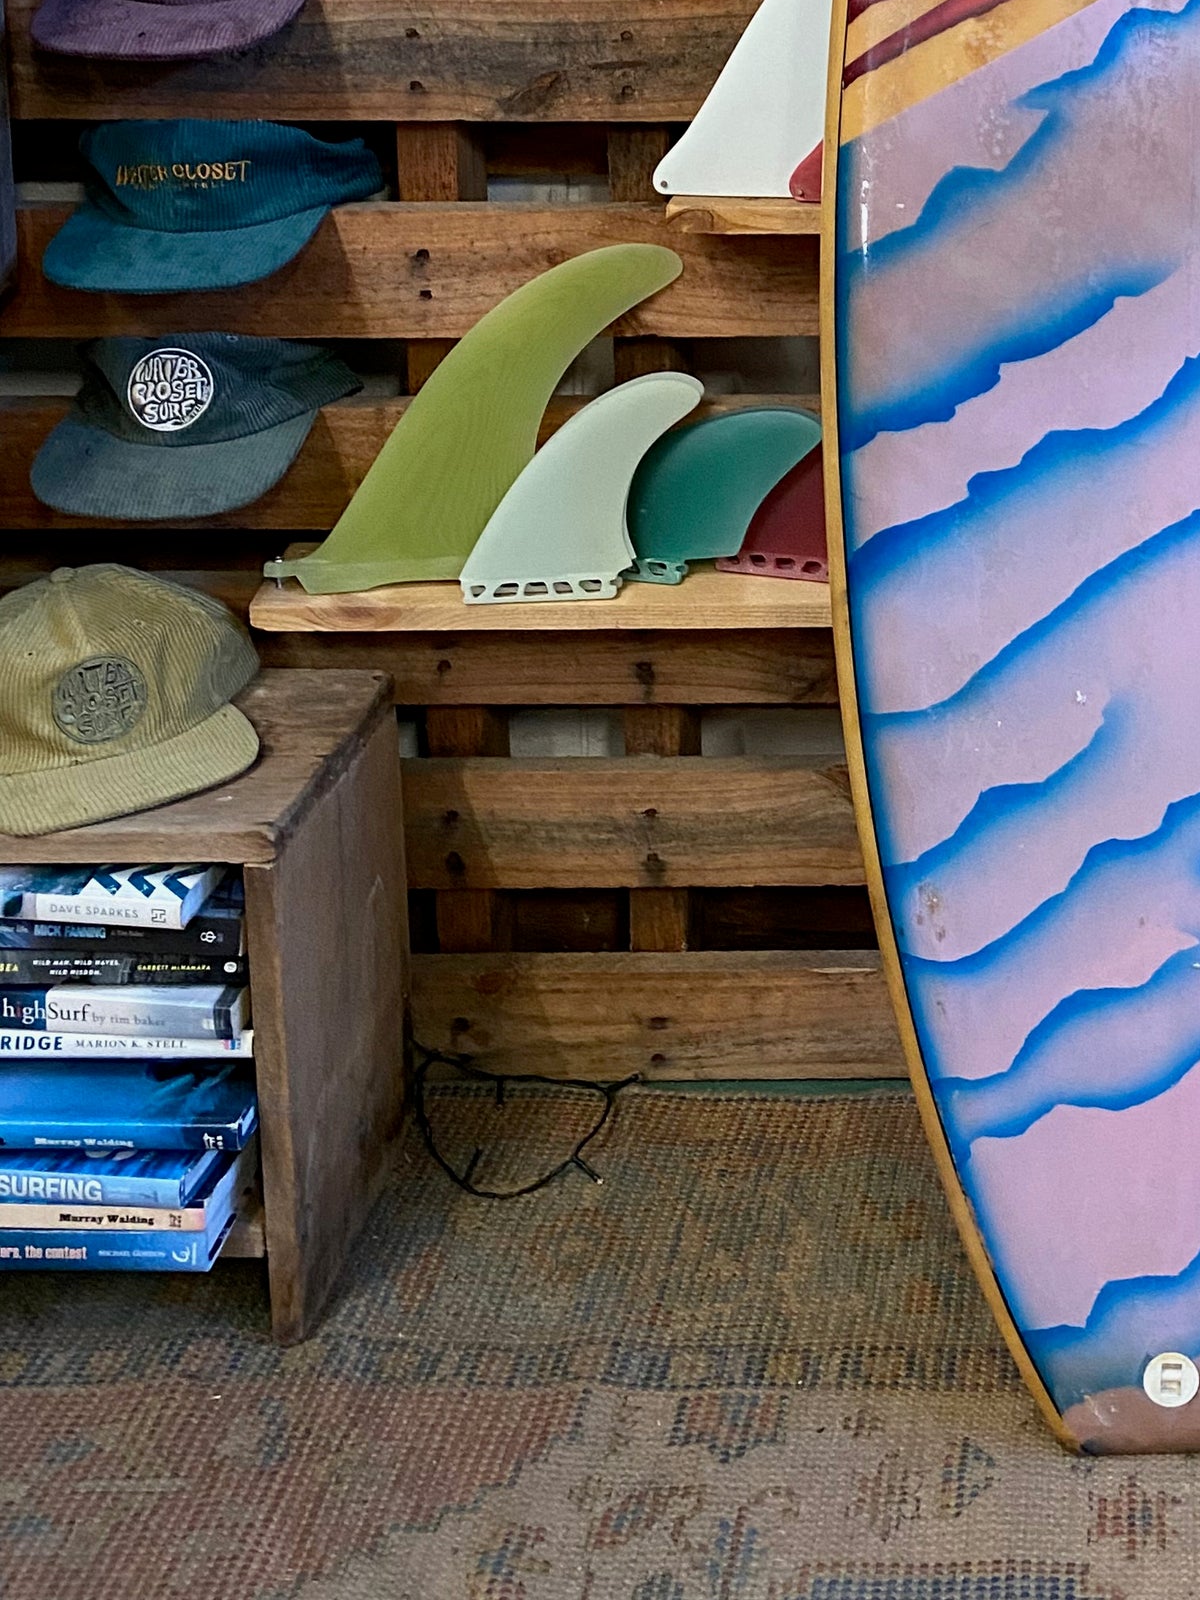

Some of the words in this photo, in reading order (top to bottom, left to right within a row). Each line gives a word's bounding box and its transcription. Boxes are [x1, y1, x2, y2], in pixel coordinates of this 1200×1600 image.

[172, 160, 252, 182] CLOSET
[135, 354, 202, 382] WATER
[131, 377, 207, 405] CLOSET
[143, 399, 196, 423] SURF
[50, 903, 82, 915] DAVE
[85, 906, 139, 919] SPARKES
[34, 925, 61, 937] MICK
[64, 926, 106, 939] FANNING
[0, 963, 19, 972] SEA
[92, 1010, 106, 1026] by
[110, 1012, 130, 1025] tim
[134, 1013, 166, 1027] baker
[0, 1035, 63, 1050] RIDGE
[75, 1039, 128, 1049] MARION
[34, 1136, 81, 1148] Murray
[83, 1137, 134, 1148] Walding
[0, 1173, 102, 1201] SURFING
[59, 1213, 104, 1224] Murray
[107, 1214, 154, 1226] Walding
